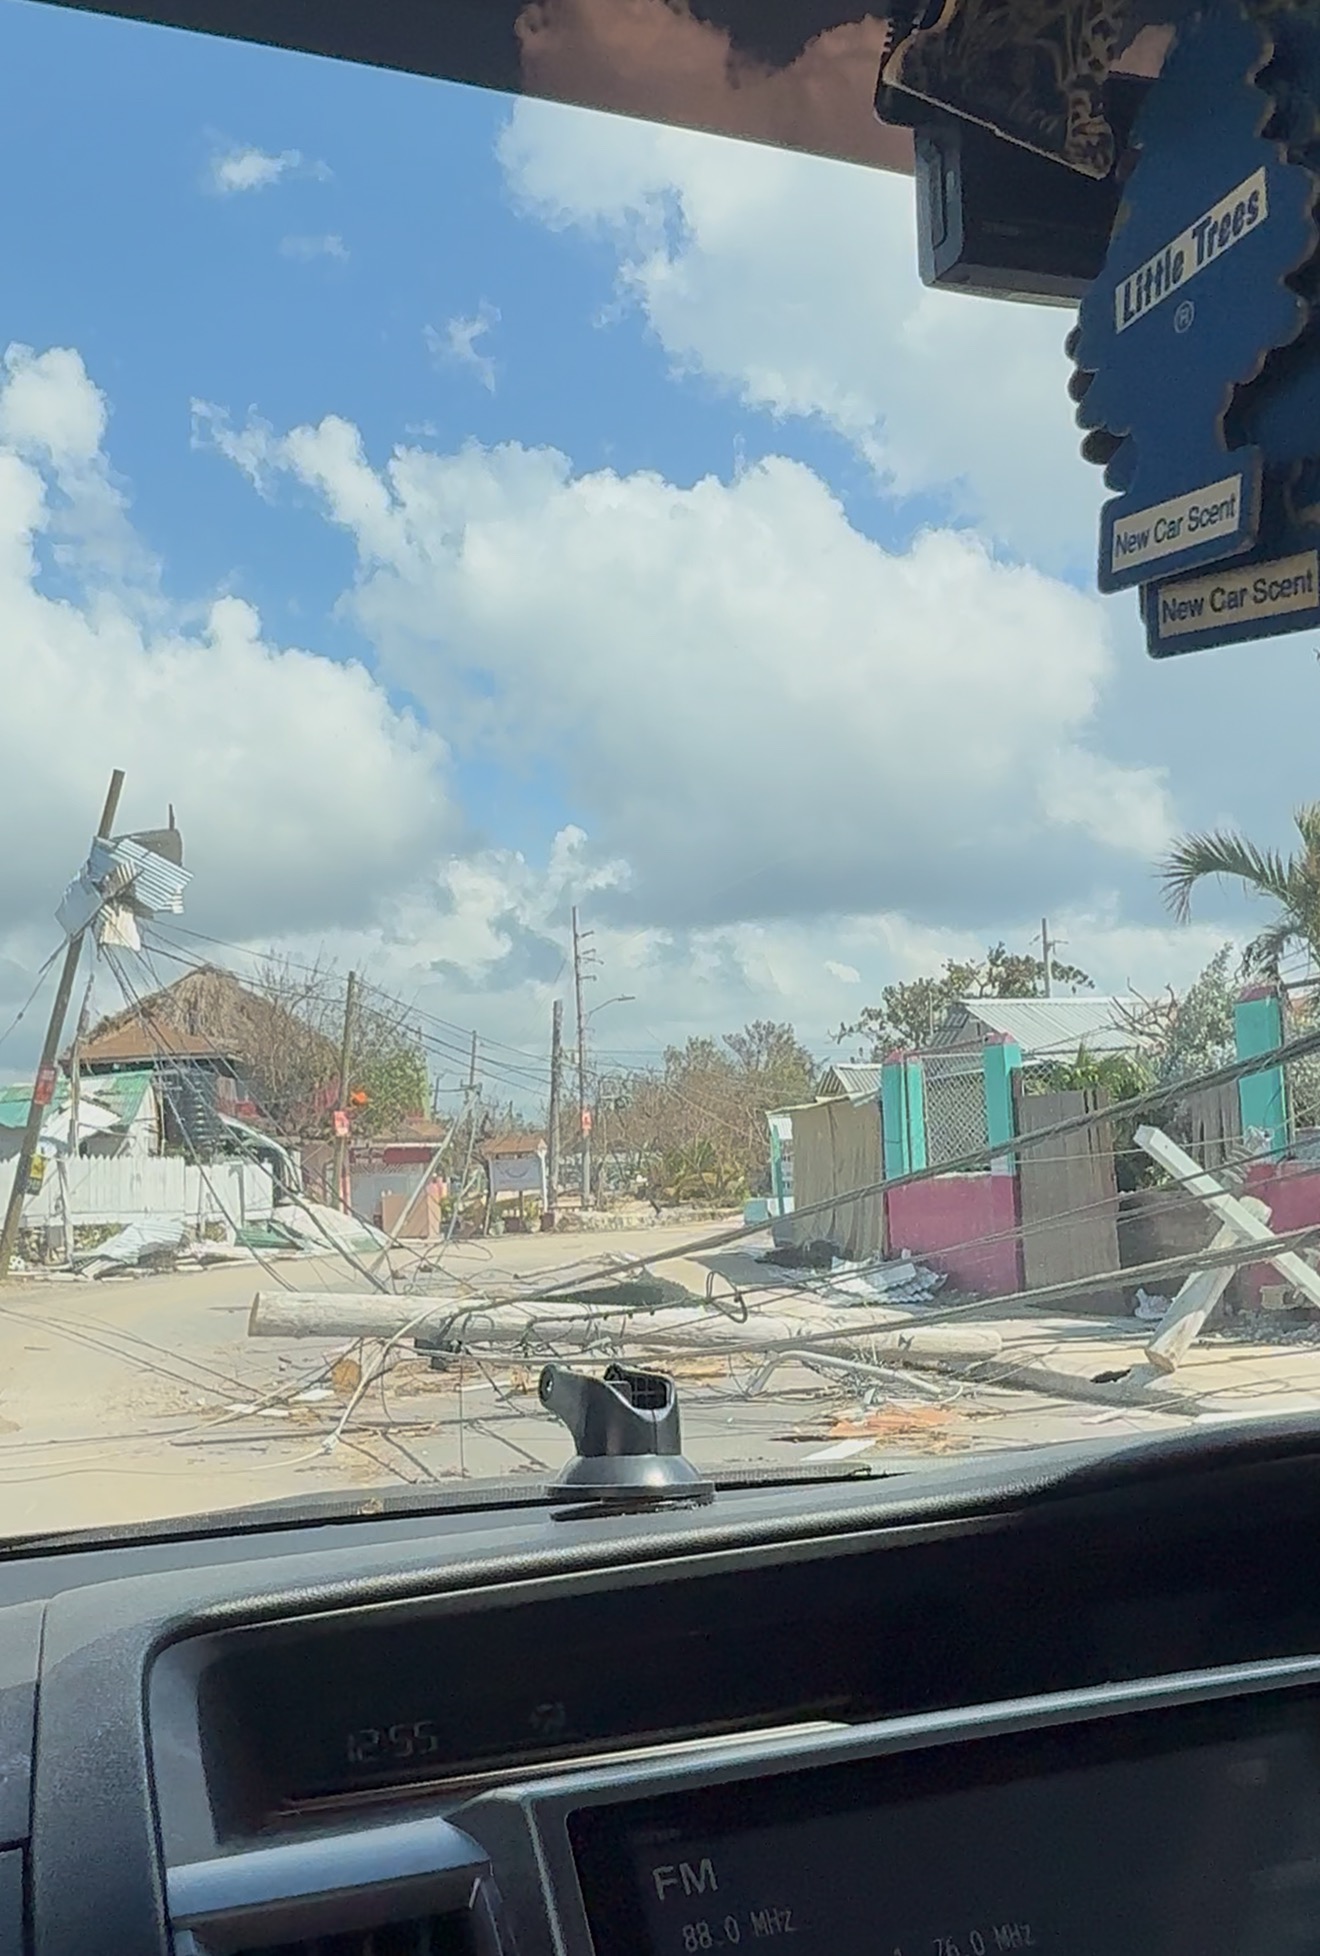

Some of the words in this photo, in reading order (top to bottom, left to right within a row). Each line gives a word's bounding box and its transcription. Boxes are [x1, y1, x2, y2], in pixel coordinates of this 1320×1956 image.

[1123, 247, 1185, 323] Little
[1192, 188, 1260, 266] Trees
[1115, 526, 1149, 558] New
[1153, 516, 1183, 544] Car
[1187, 493, 1237, 532] Scent
[1161, 596, 1204, 624] New
[1209, 586, 1249, 613] Car
[1252, 568, 1314, 604] Scent
[651, 1857, 719, 1900] FM
[682, 1916, 741, 1953] 88.0
[751, 1908, 798, 1937] MHz
[995, 1922, 1037, 1950] MHz
